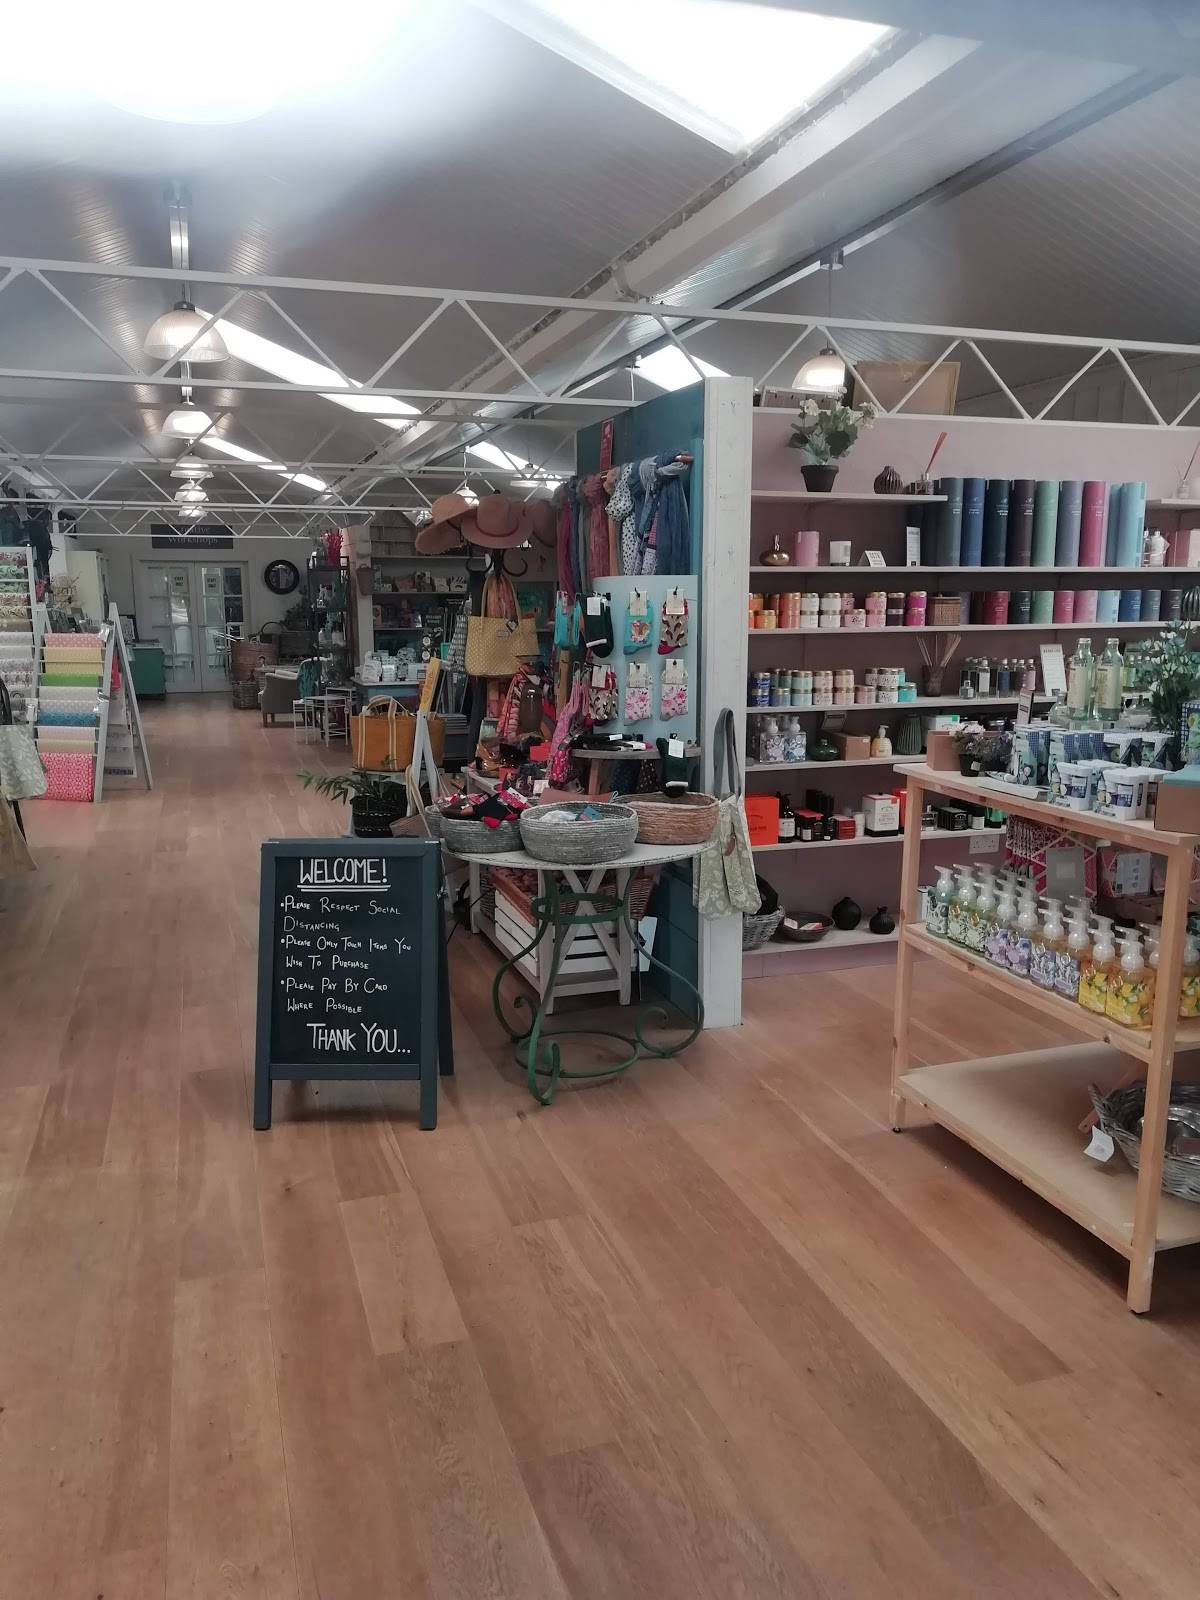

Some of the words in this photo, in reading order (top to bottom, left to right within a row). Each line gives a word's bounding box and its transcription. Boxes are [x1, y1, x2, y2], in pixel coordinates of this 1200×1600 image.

[300, 858, 388, 883] WELCOME!
[306, 1023, 357, 1051] THANK
[360, 1023, 411, 1054] YOU...
